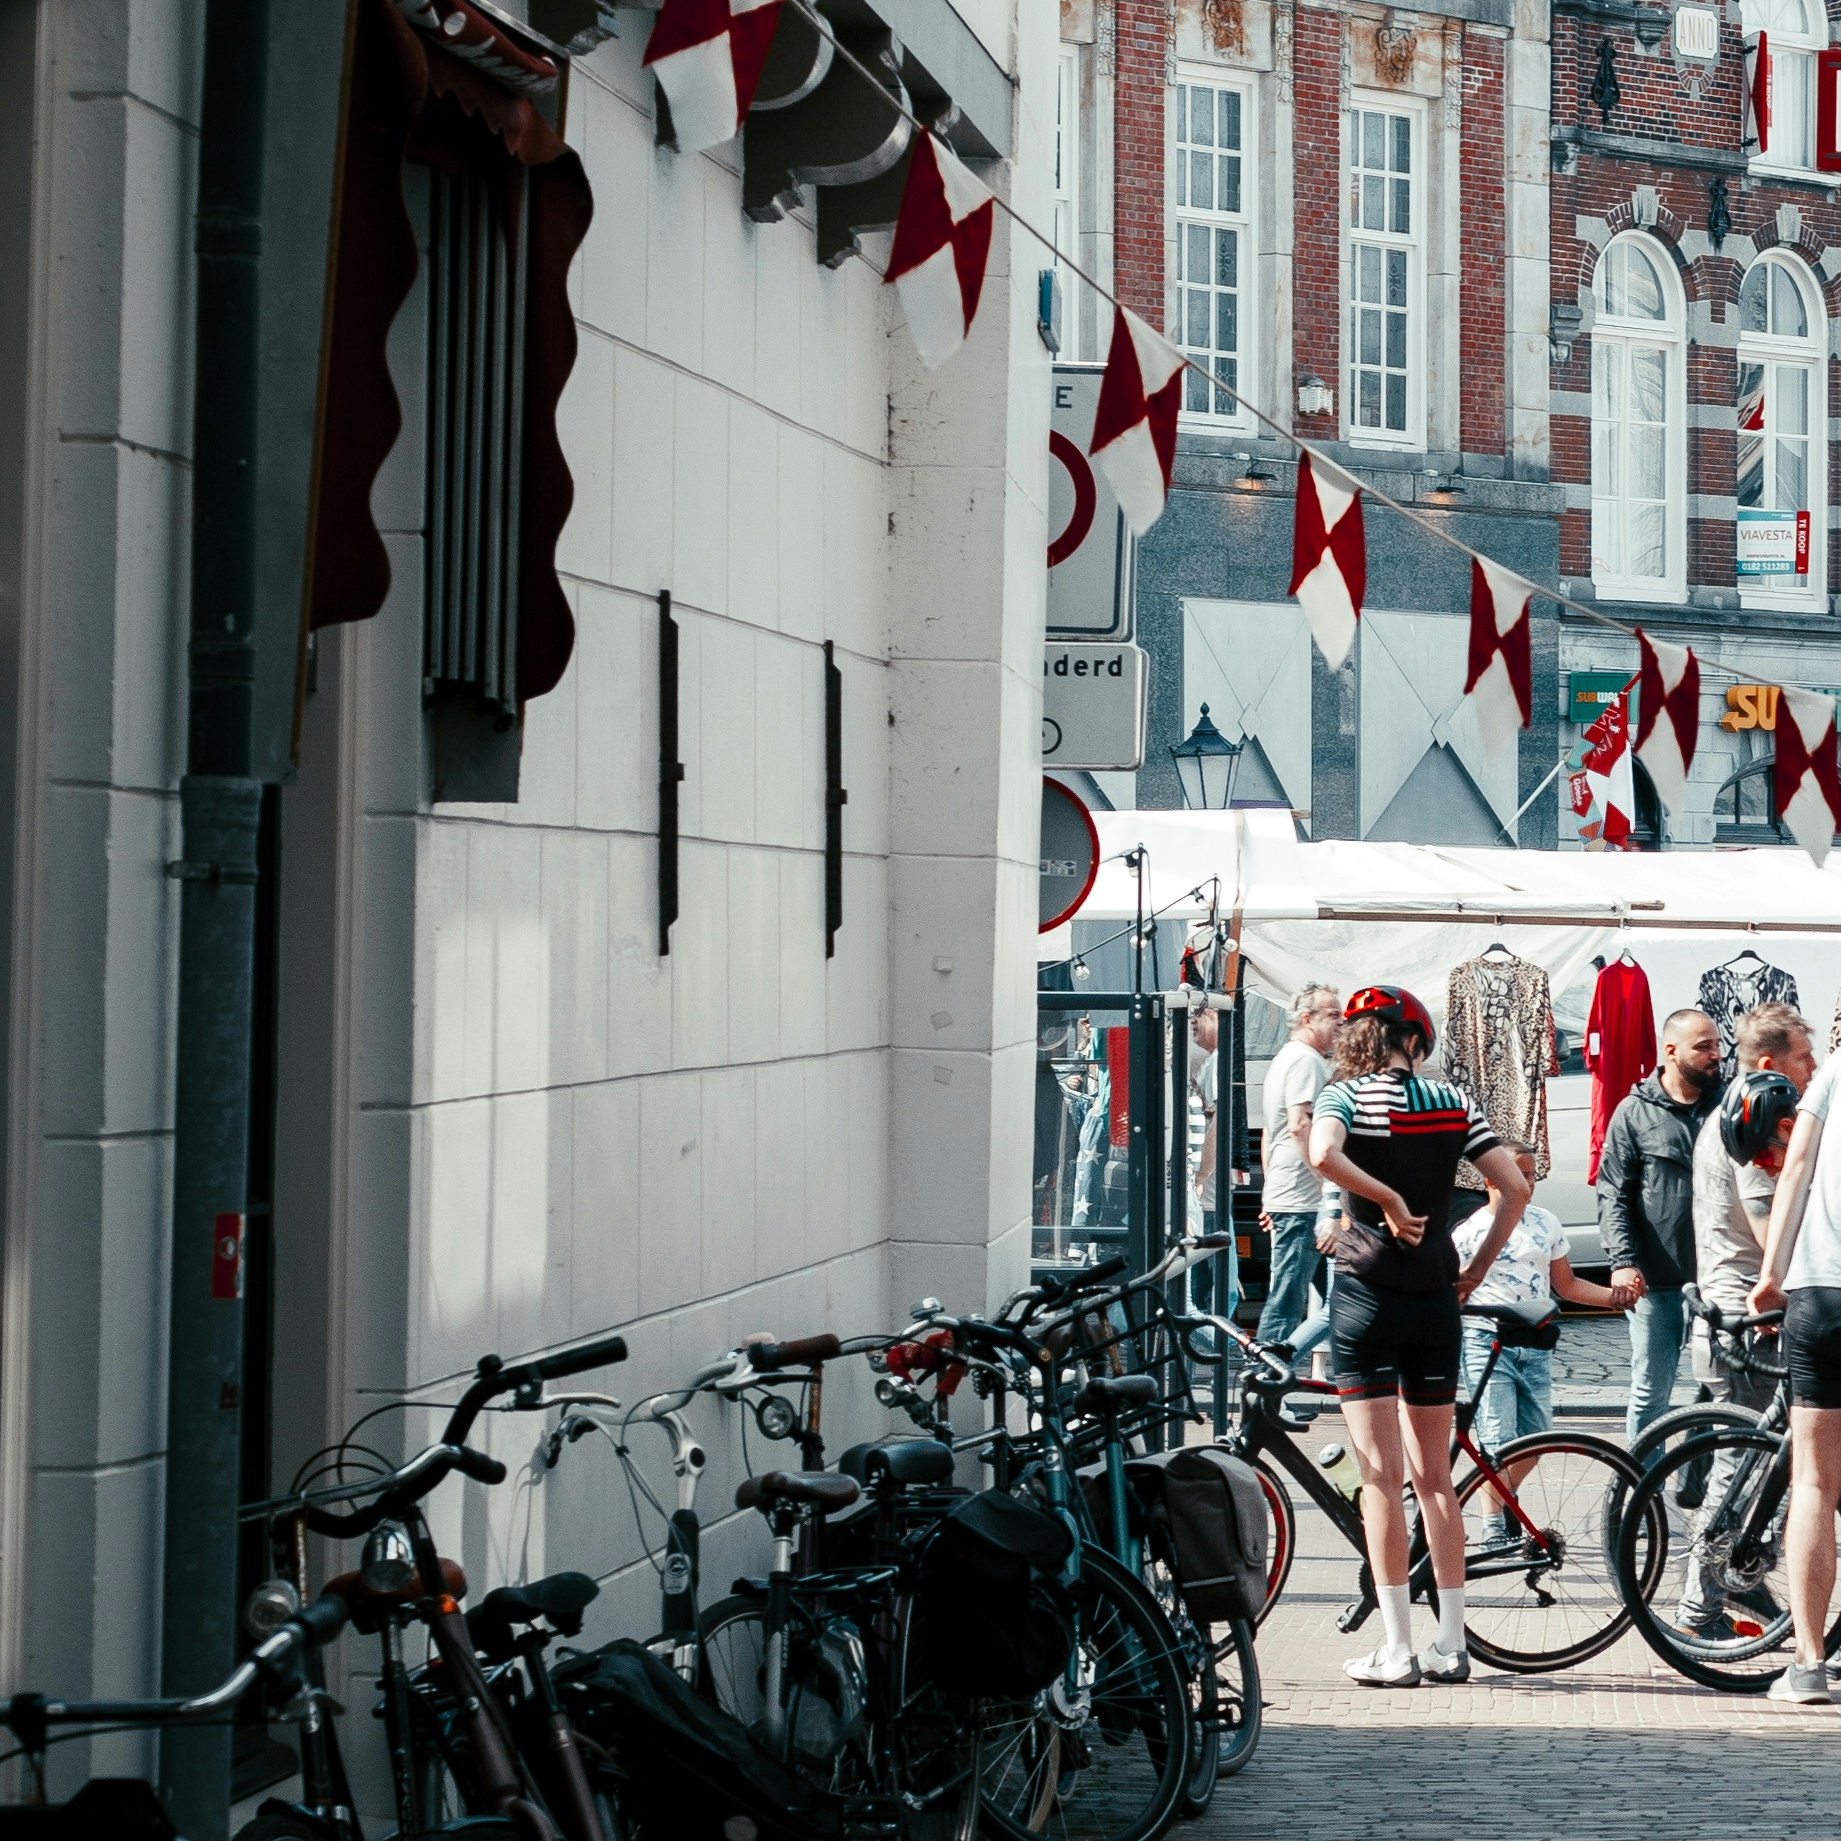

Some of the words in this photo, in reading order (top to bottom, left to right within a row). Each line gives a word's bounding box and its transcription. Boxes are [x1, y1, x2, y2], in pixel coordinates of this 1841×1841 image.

[1680, 14, 1714, 51] ANNO
[1798, 519, 1807, 529] TE
[1740, 529, 1793, 541] VIAVESTA
[1798, 530, 1807, 554] KOOP
[1741, 562, 1761, 571] 0182
[1762, 562, 1790, 571] 511283
[1044, 653, 1123, 677] derd
[1575, 691, 1620, 704] SUBWA
